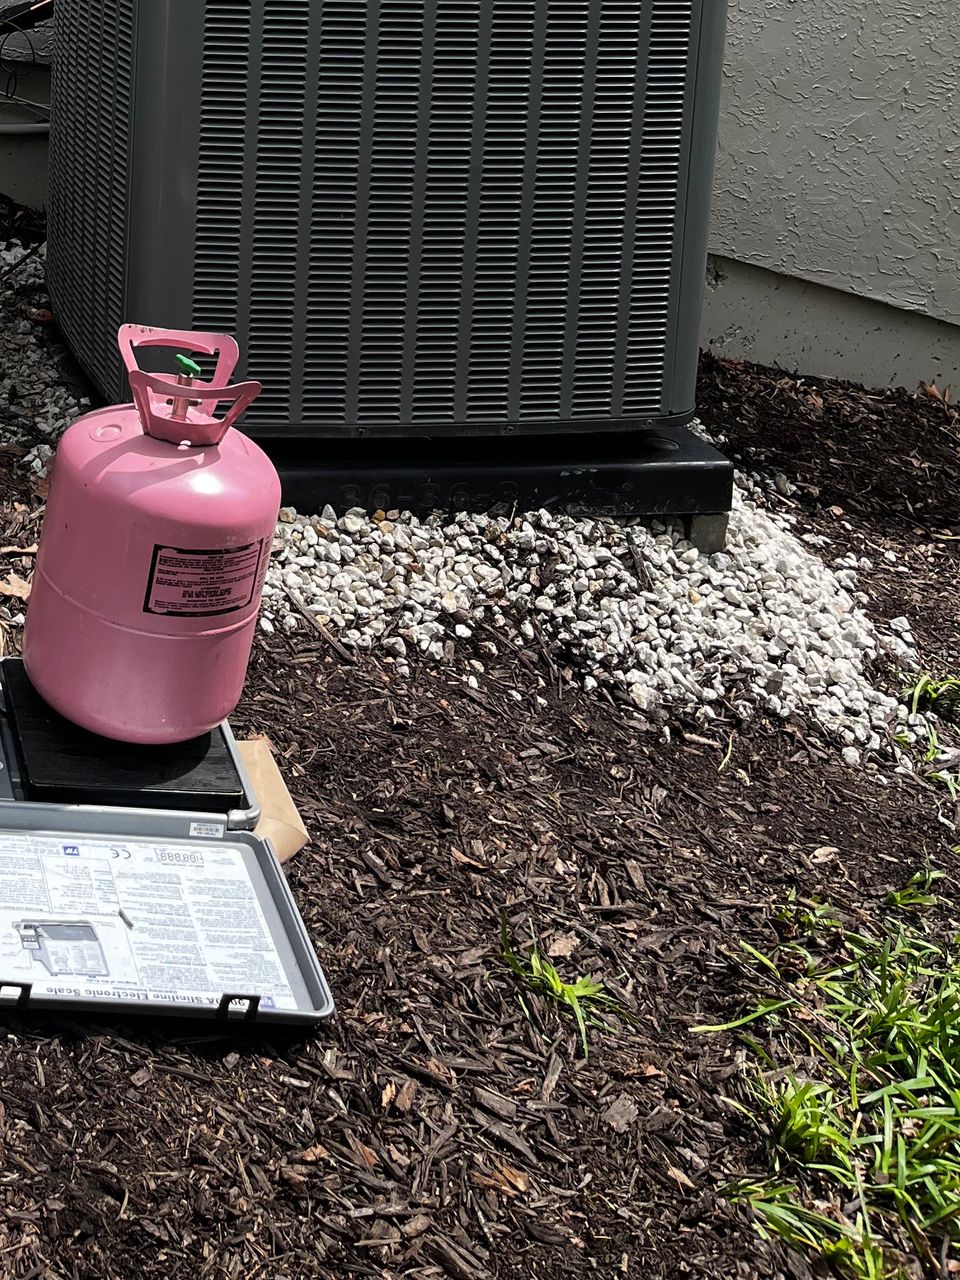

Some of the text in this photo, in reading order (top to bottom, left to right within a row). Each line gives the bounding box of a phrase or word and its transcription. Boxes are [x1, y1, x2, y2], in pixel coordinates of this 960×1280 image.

[46, 986, 81, 997] Scale
[84, 989, 149, 1000] Electronic
[153, 994, 203, 1005] Slimline
